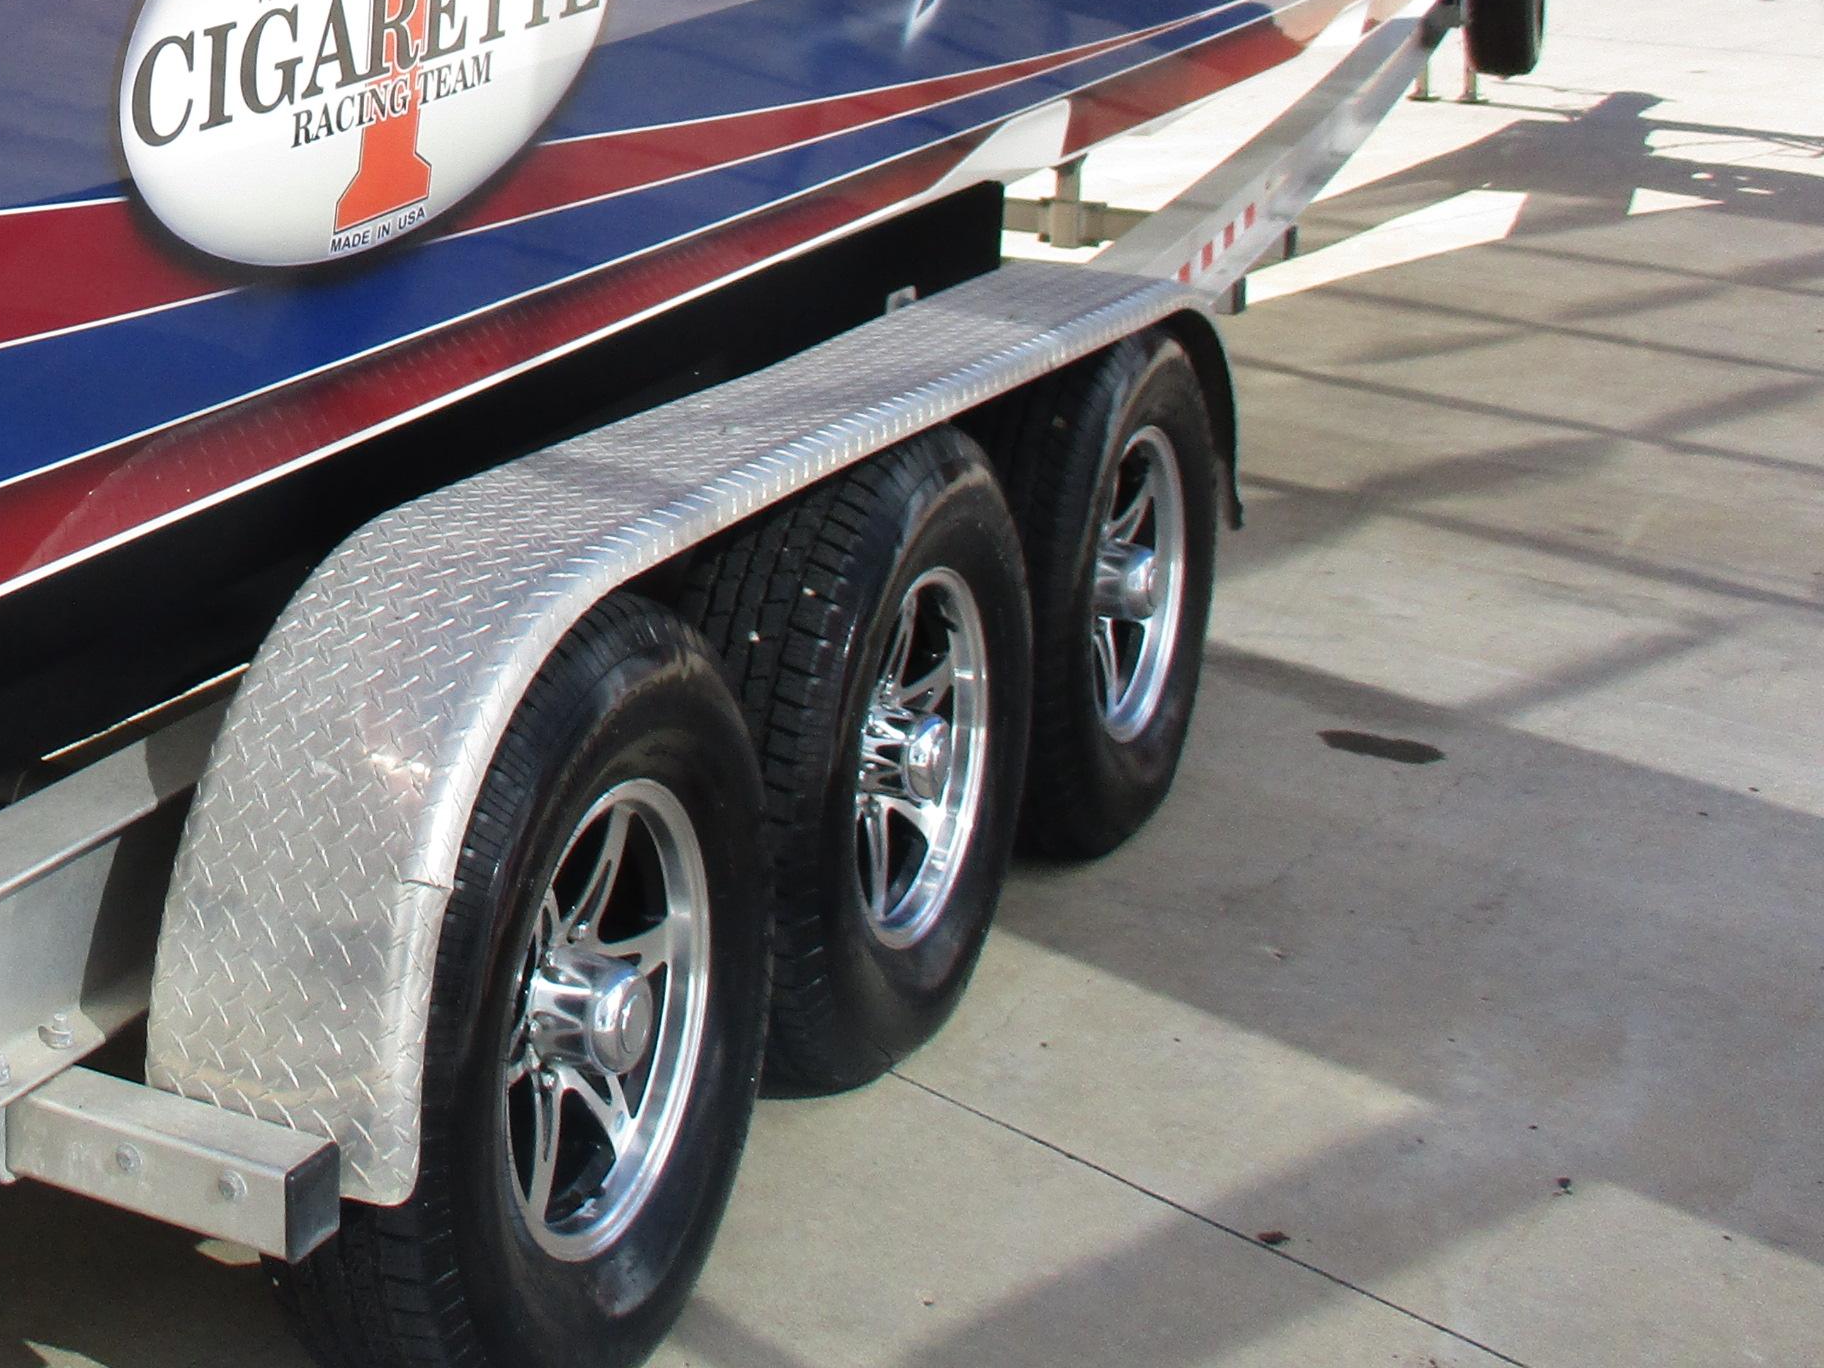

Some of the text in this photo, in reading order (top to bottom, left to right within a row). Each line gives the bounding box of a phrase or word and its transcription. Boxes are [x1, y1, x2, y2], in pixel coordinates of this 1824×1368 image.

[291, 51, 493, 149] RACING TEAM
[329, 206, 427, 254] MADE IN USA
